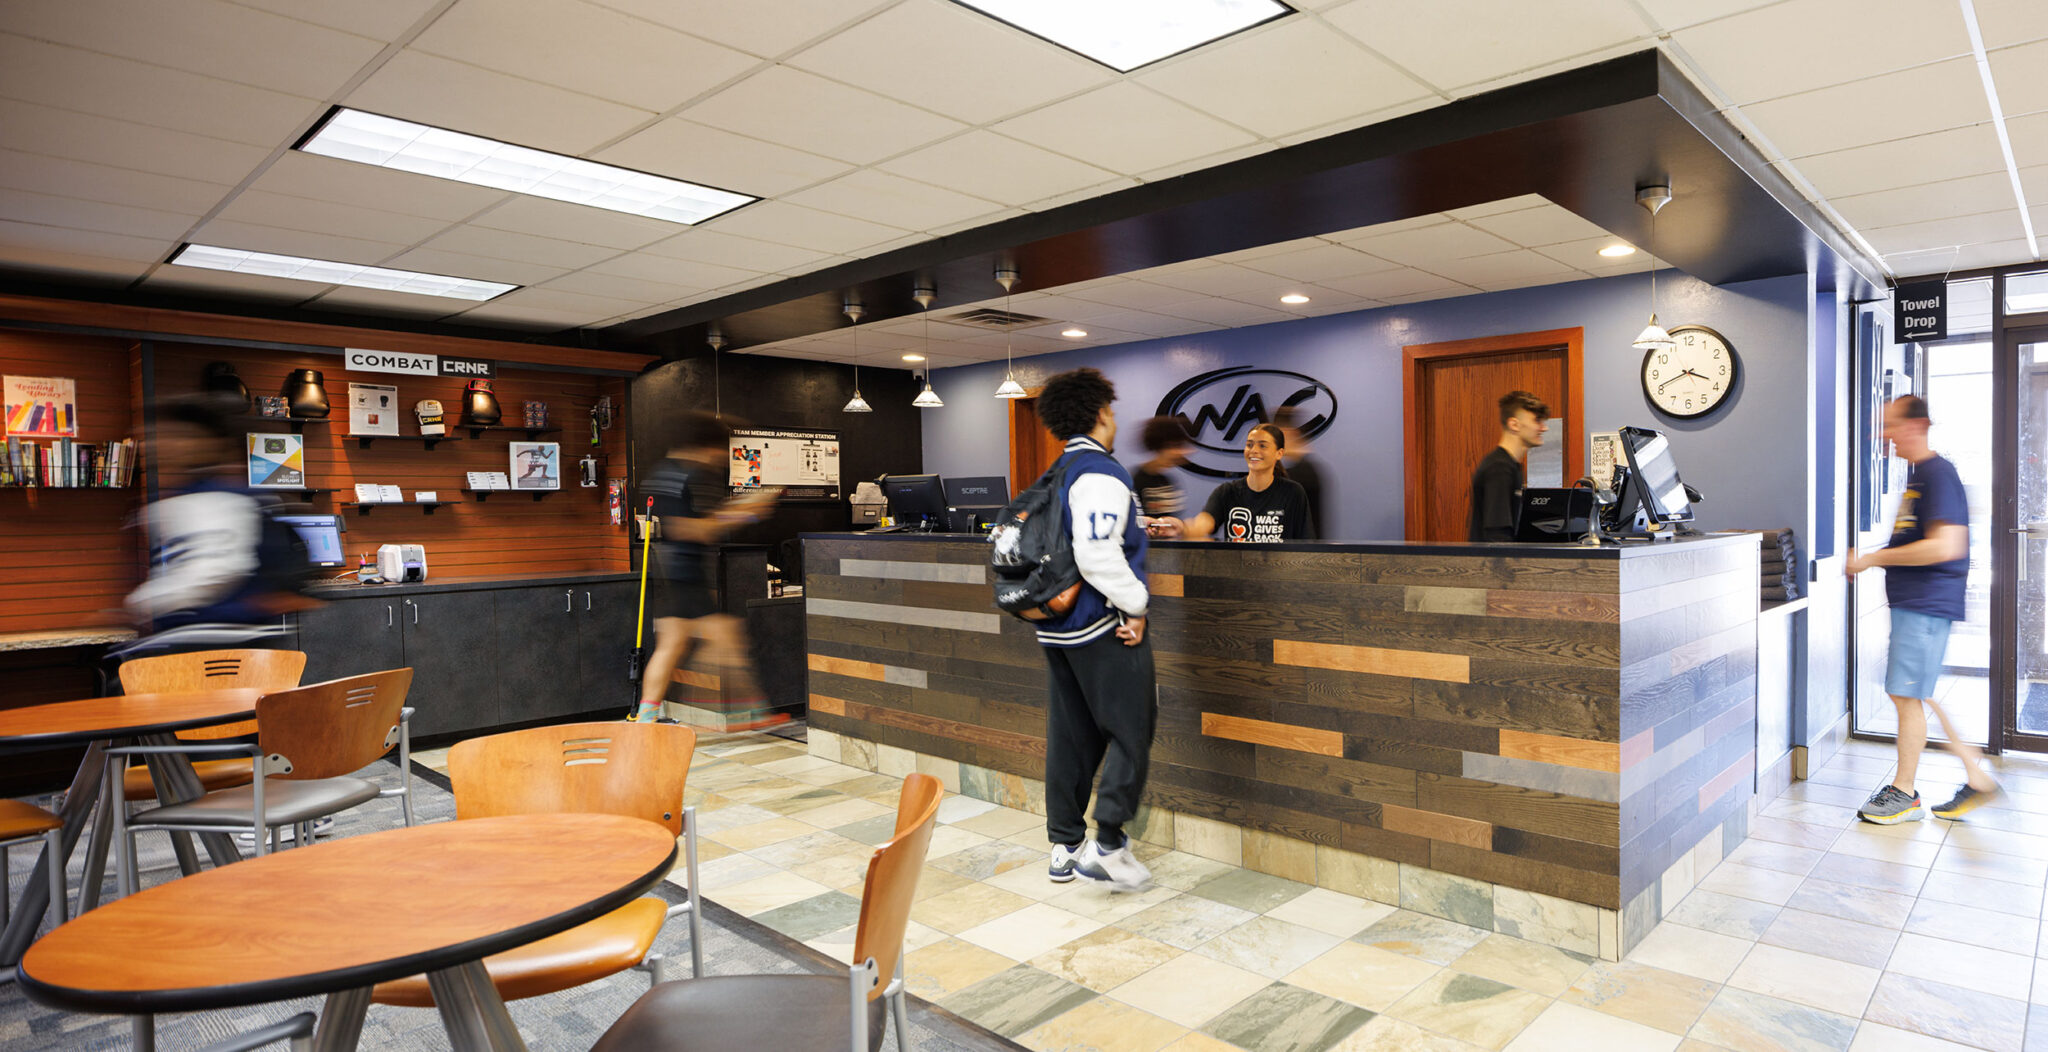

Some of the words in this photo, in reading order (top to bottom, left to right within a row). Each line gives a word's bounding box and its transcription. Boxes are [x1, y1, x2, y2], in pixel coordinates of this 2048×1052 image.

[1900, 296, 1940, 312] Towel
[1904, 316, 1937, 329] Drop
[1683, 335, 1695, 346] 12
[1702, 340, 1707, 350] 1
[1657, 354, 1669, 365] 10
[1713, 349, 1720, 360] 2
[351, 353, 433, 370] COMBAT
[442, 360, 489, 375] CRNR
[1652, 369, 1659, 380] 9
[1718, 365, 1726, 376] 3
[1657, 384, 1665, 396] 8
[1712, 381, 1720, 392] 4
[1670, 395, 1677, 406] 7
[1684, 398, 1692, 410] 6
[1700, 393, 1708, 405] 5
[1175, 383, 1327, 442] WAC
[775, 431, 815, 439] APPRECIATION
[961, 487, 988, 495] SCEPTRE
[1530, 497, 1551, 505] acer
[1087, 511, 1118, 540] 17
[1255, 515, 1279, 525] WAC
[1254, 524, 1284, 534] GIVES
